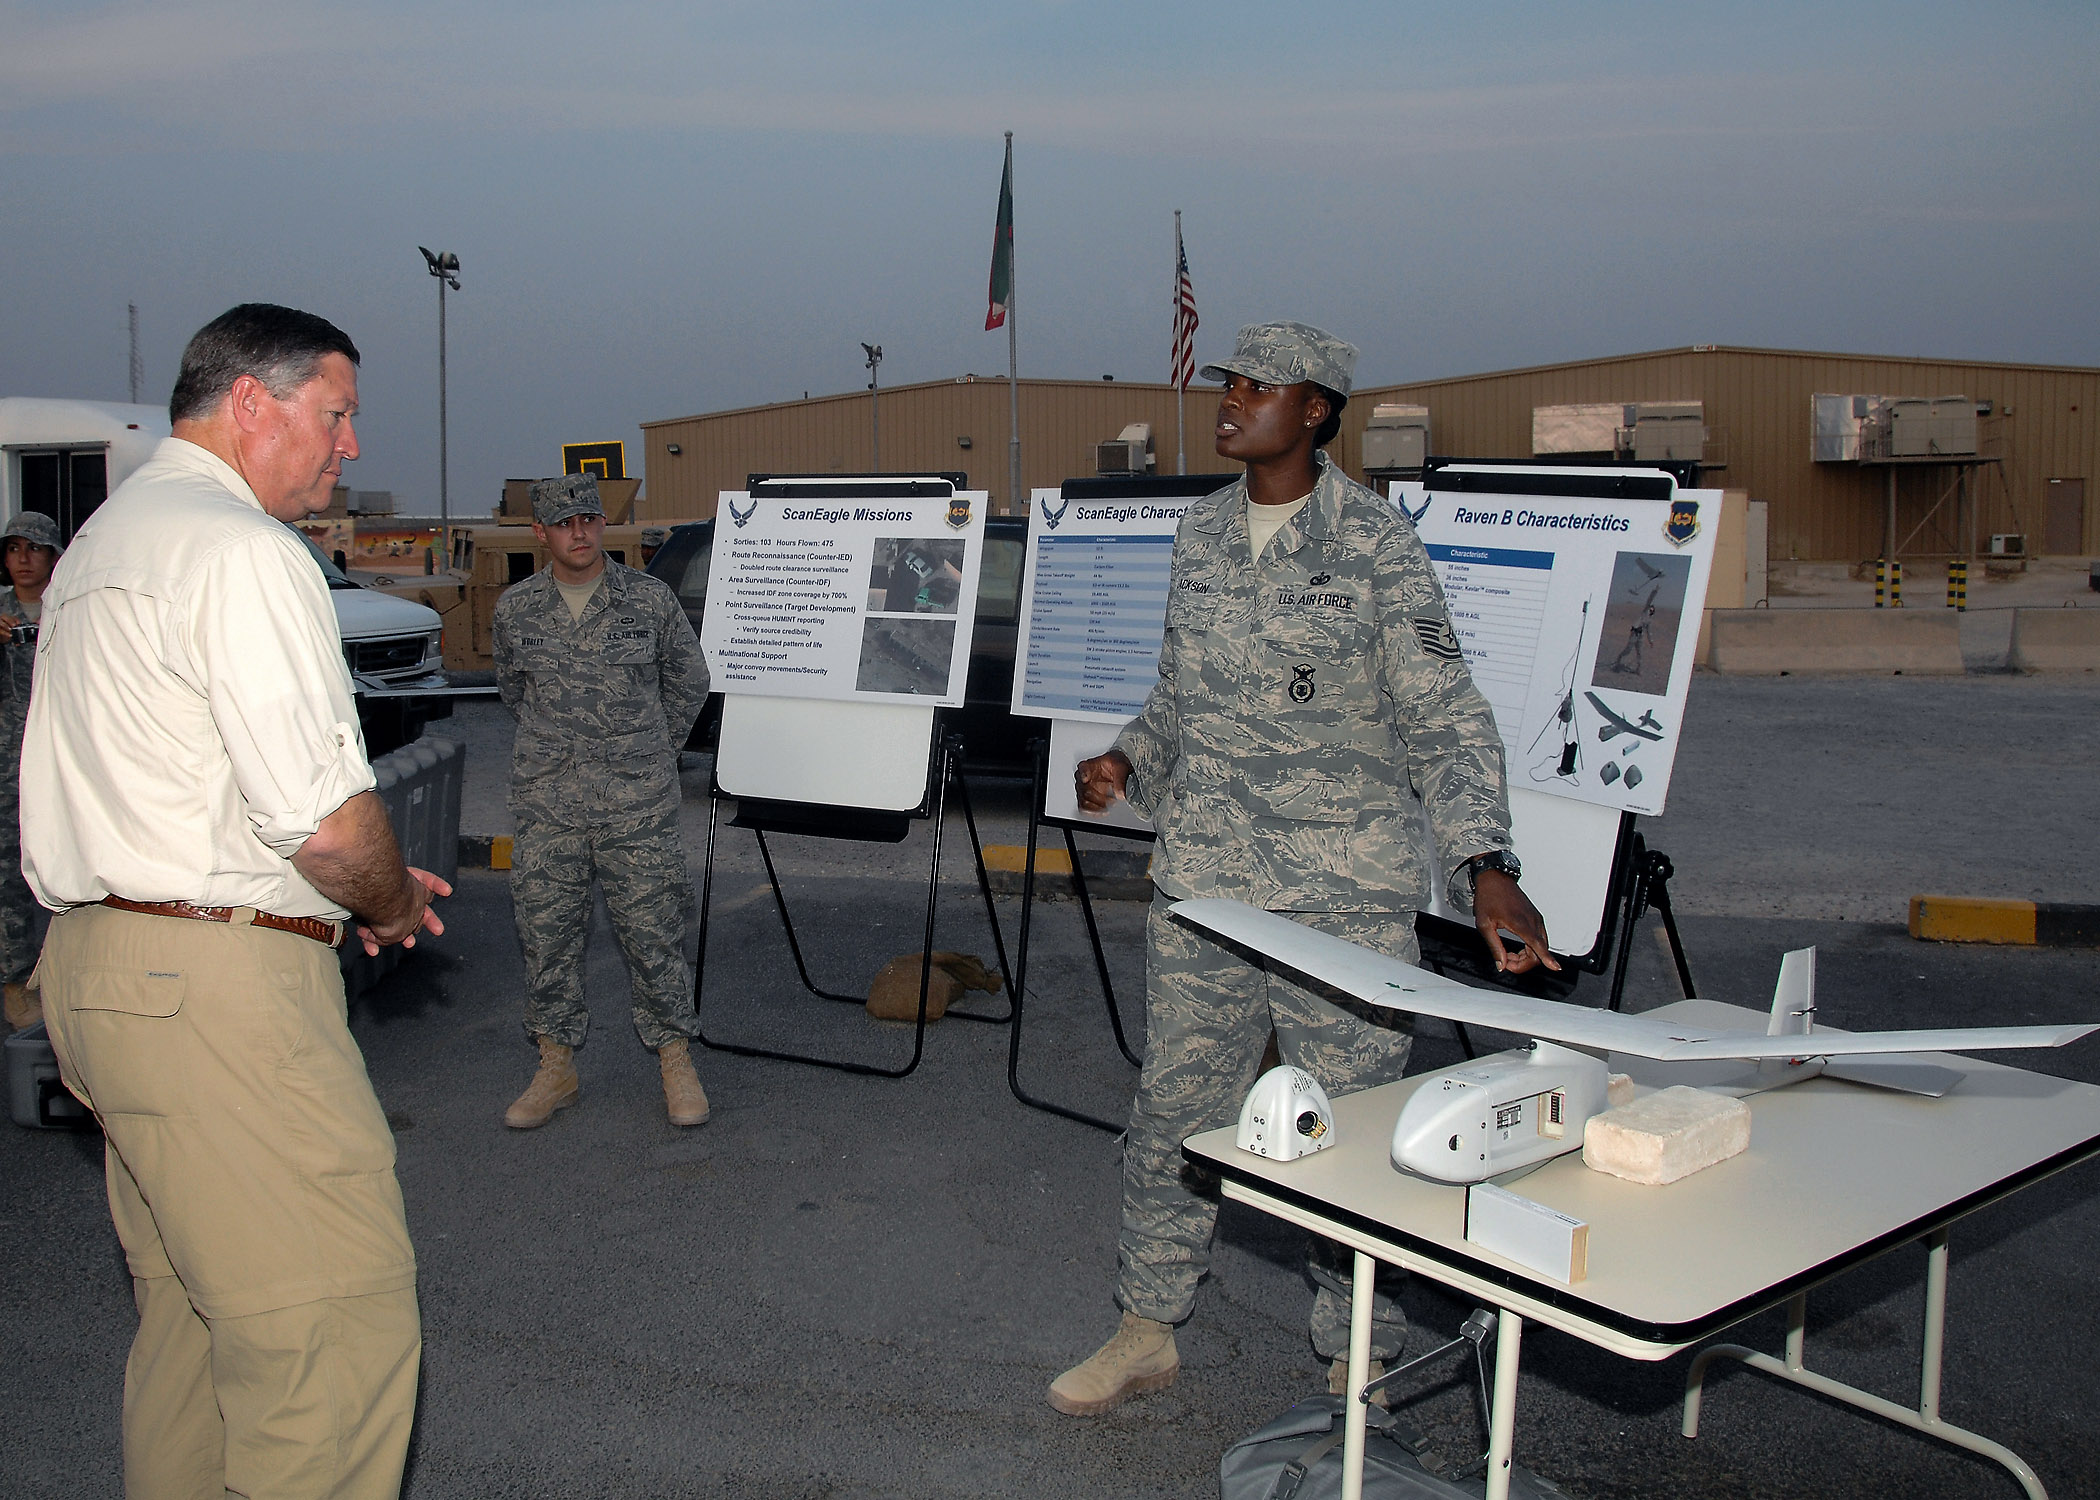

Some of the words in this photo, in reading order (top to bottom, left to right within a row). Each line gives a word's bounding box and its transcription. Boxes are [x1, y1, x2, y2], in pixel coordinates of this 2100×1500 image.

[782, 507, 850, 523] ScanEagle
[853, 508, 913, 521] Missions
[1076, 505, 1137, 522] ScanEagle
[1454, 507, 1498, 524] Raven
[1501, 509, 1514, 525] B
[1516, 510, 1630, 531] Characteristics
[733, 538, 759, 546] Sorties:
[760, 538, 772, 546] 103
[776, 539, 796, 547] Hours
[797, 539, 820, 547] Flown:
[821, 539, 834, 547] 475
[731, 551, 751, 559] Route
[752, 551, 806, 560] Reconnaissance
[806, 552, 853, 562] (Counter-IED)
[1450, 549, 1489, 559] Characteristic
[740, 563, 765, 571] Doubled
[728, 576, 744, 584] Area
[745, 577, 785, 585] Surveillance
[785, 578, 831, 587] (Counter-IDF)
[736, 589, 766, 597] Increased
[766, 589, 777, 597] IDF
[793, 591, 821, 600] coverage
[821, 592, 830, 600] by
[1485, 588, 1511, 596] composite
[725, 600, 742, 609] Point
[743, 601, 783, 610] Surveillance
[784, 603, 809, 612] (Target
[809, 603, 856, 614] Development)
[1278, 594, 1296, 605] U.S.
[1297, 594, 1316, 606] AIR
[1317, 593, 1354, 610] FORCE
[733, 613, 771, 623] Cross-queue
[771, 615, 796, 623] HUMINT
[796, 617, 825, 625] reporting
[742, 626, 760, 635] Verify
[781, 628, 812, 637] credibility
[730, 637, 758, 645] Establish
[812, 641, 823, 649] life
[718, 649, 760, 659] Multinational
[760, 651, 788, 661] Support
[726, 662, 744, 671] Major
[744, 664, 767, 673] convoy
[766, 665, 828, 676] movements/Security
[725, 673, 757, 681] assistance
